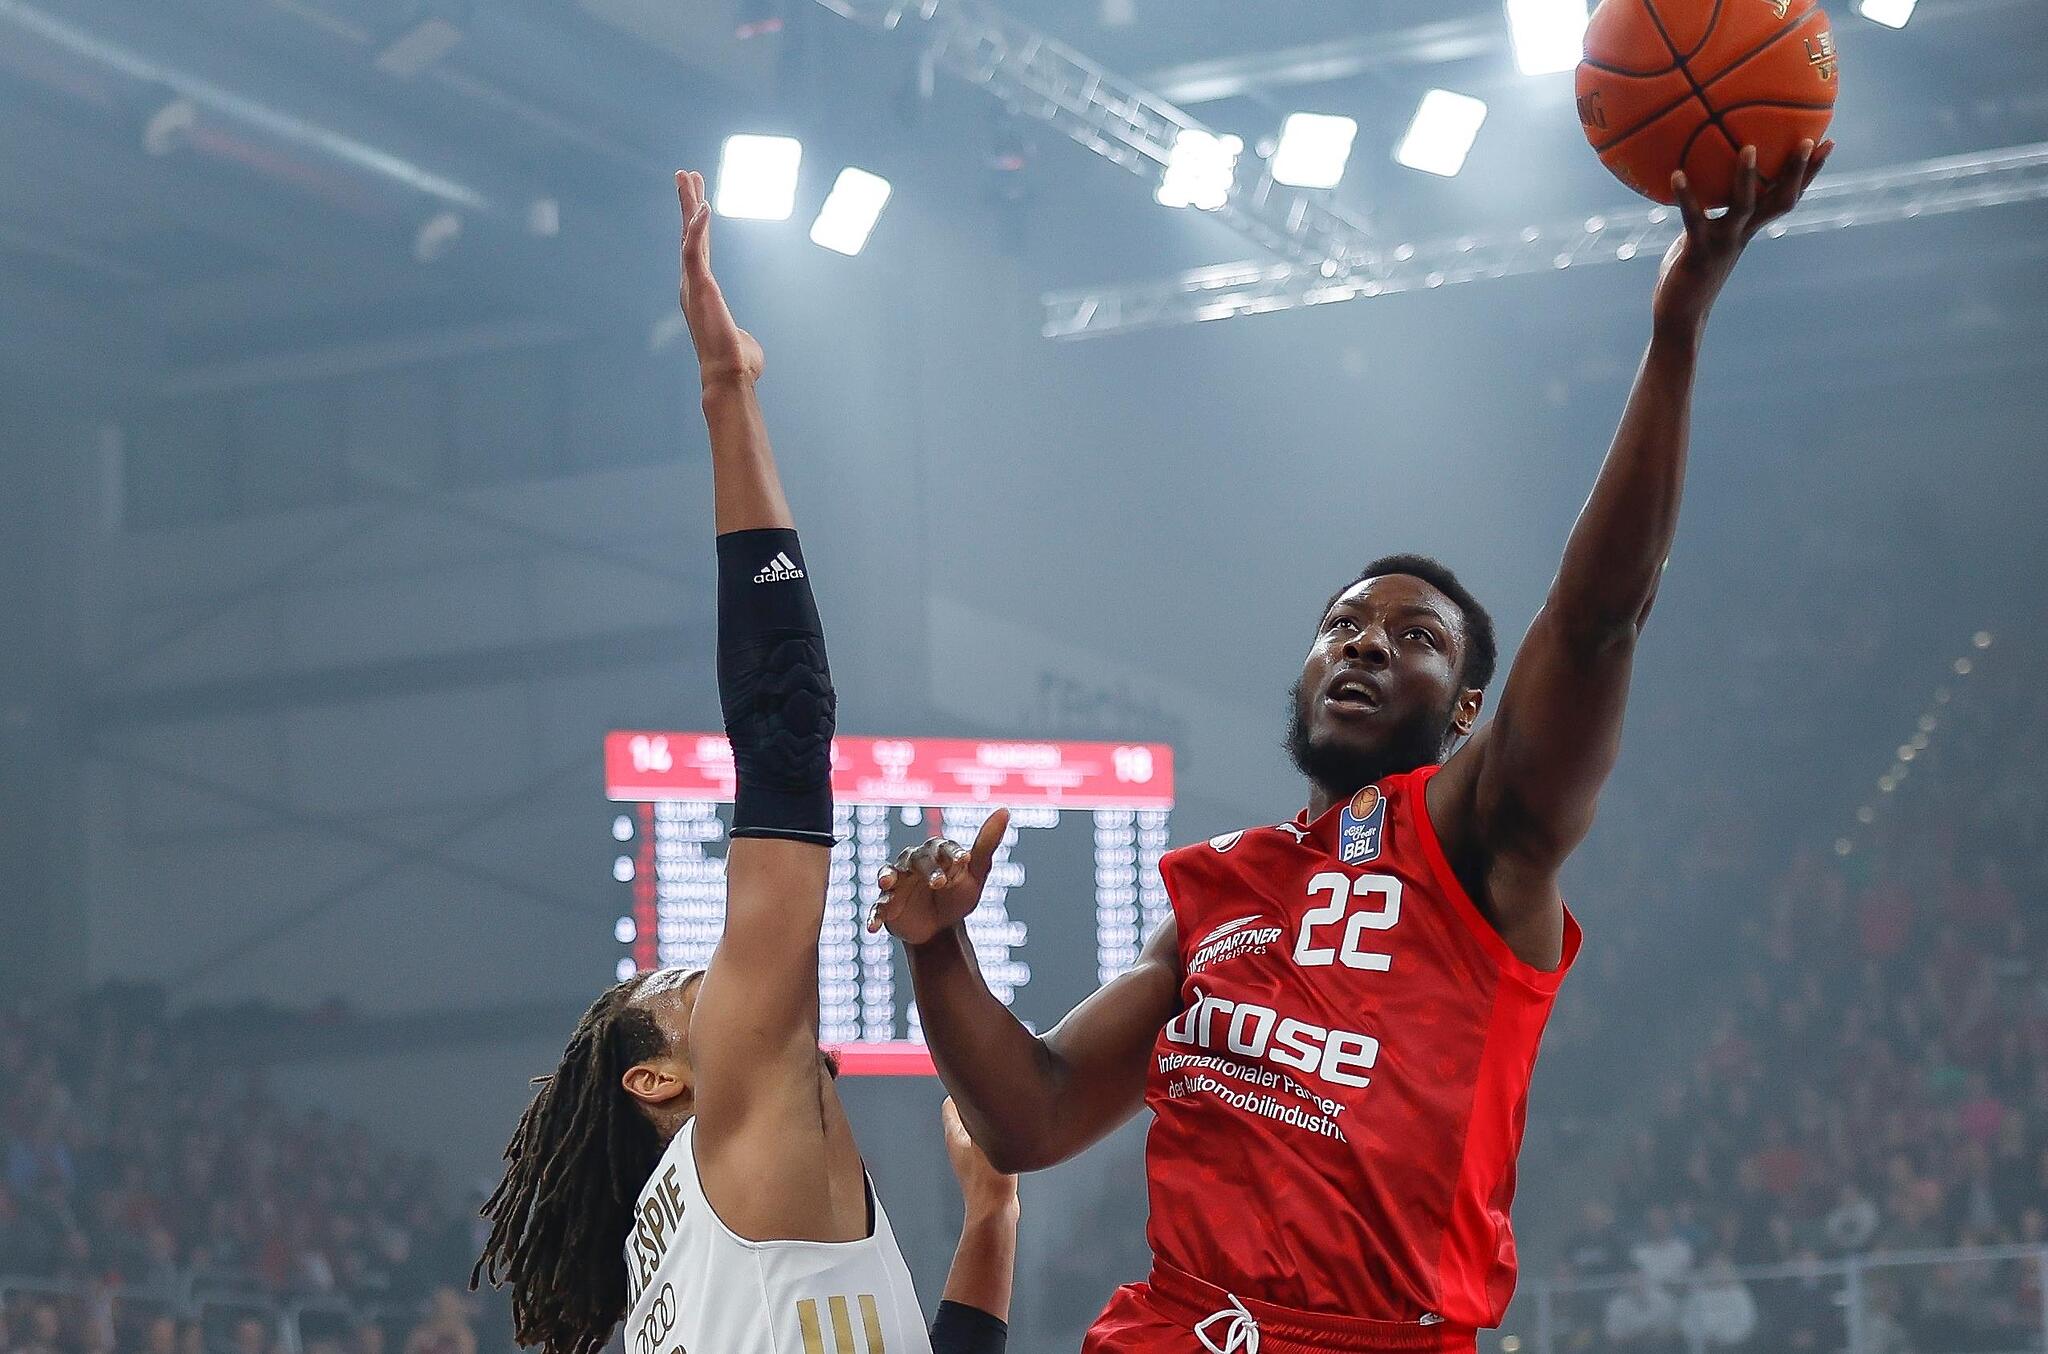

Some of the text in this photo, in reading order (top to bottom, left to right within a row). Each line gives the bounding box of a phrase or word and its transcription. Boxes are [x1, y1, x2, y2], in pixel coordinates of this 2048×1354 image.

[753, 568, 804, 584] adidas
[1343, 837, 1374, 862] BBL
[1292, 871, 1403, 973] 22
[1212, 944, 1267, 965] LOGISTICS
[1157, 1052, 1281, 1090] Internationaler
[1169, 1080, 1185, 1099] der
